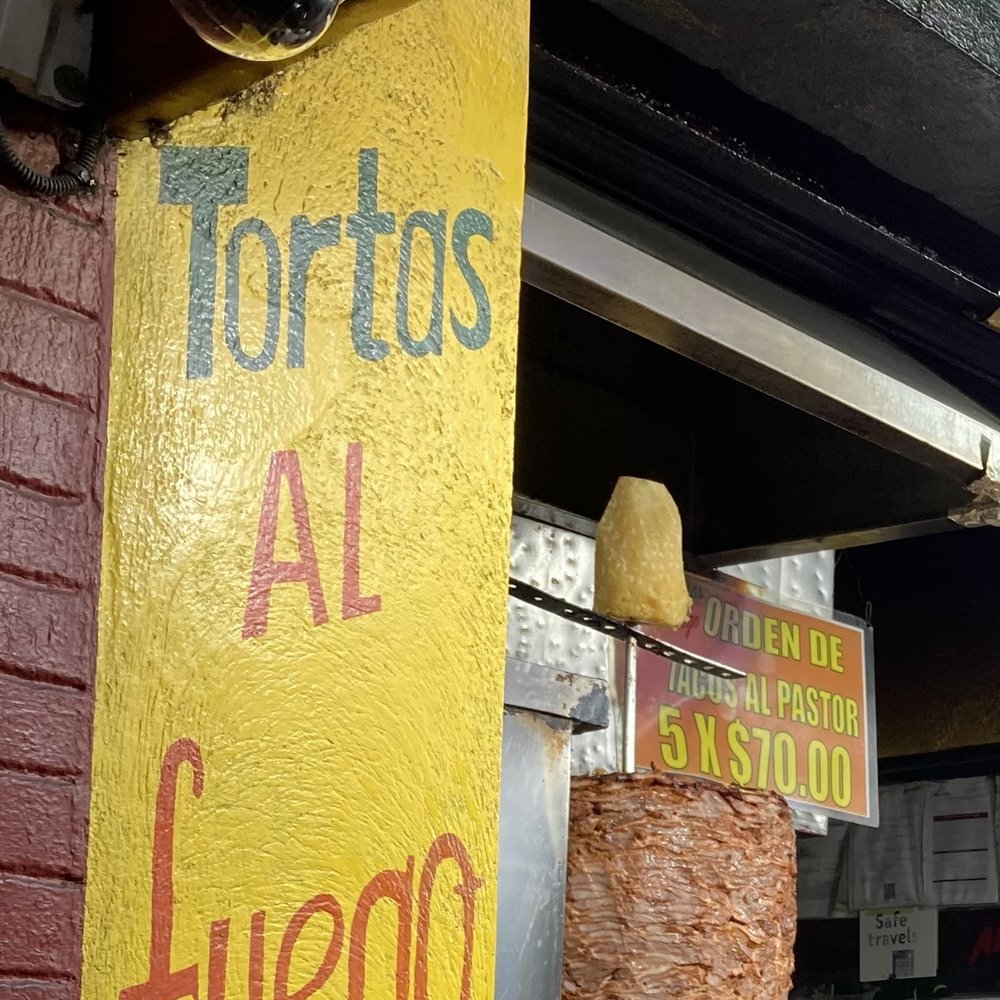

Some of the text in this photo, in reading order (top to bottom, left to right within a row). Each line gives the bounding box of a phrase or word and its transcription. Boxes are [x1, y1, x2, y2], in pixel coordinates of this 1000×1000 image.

[159, 146, 492, 380] Tortas
[242, 442, 382, 639] AL
[703, 596, 801, 661] ORDEN
[808, 628, 844, 674] DE
[745, 673, 772, 716] AL
[777, 680, 860, 738] PASTOR
[658, 704, 852, 809] 5 X $70.00
[868, 927, 918, 947] travels
